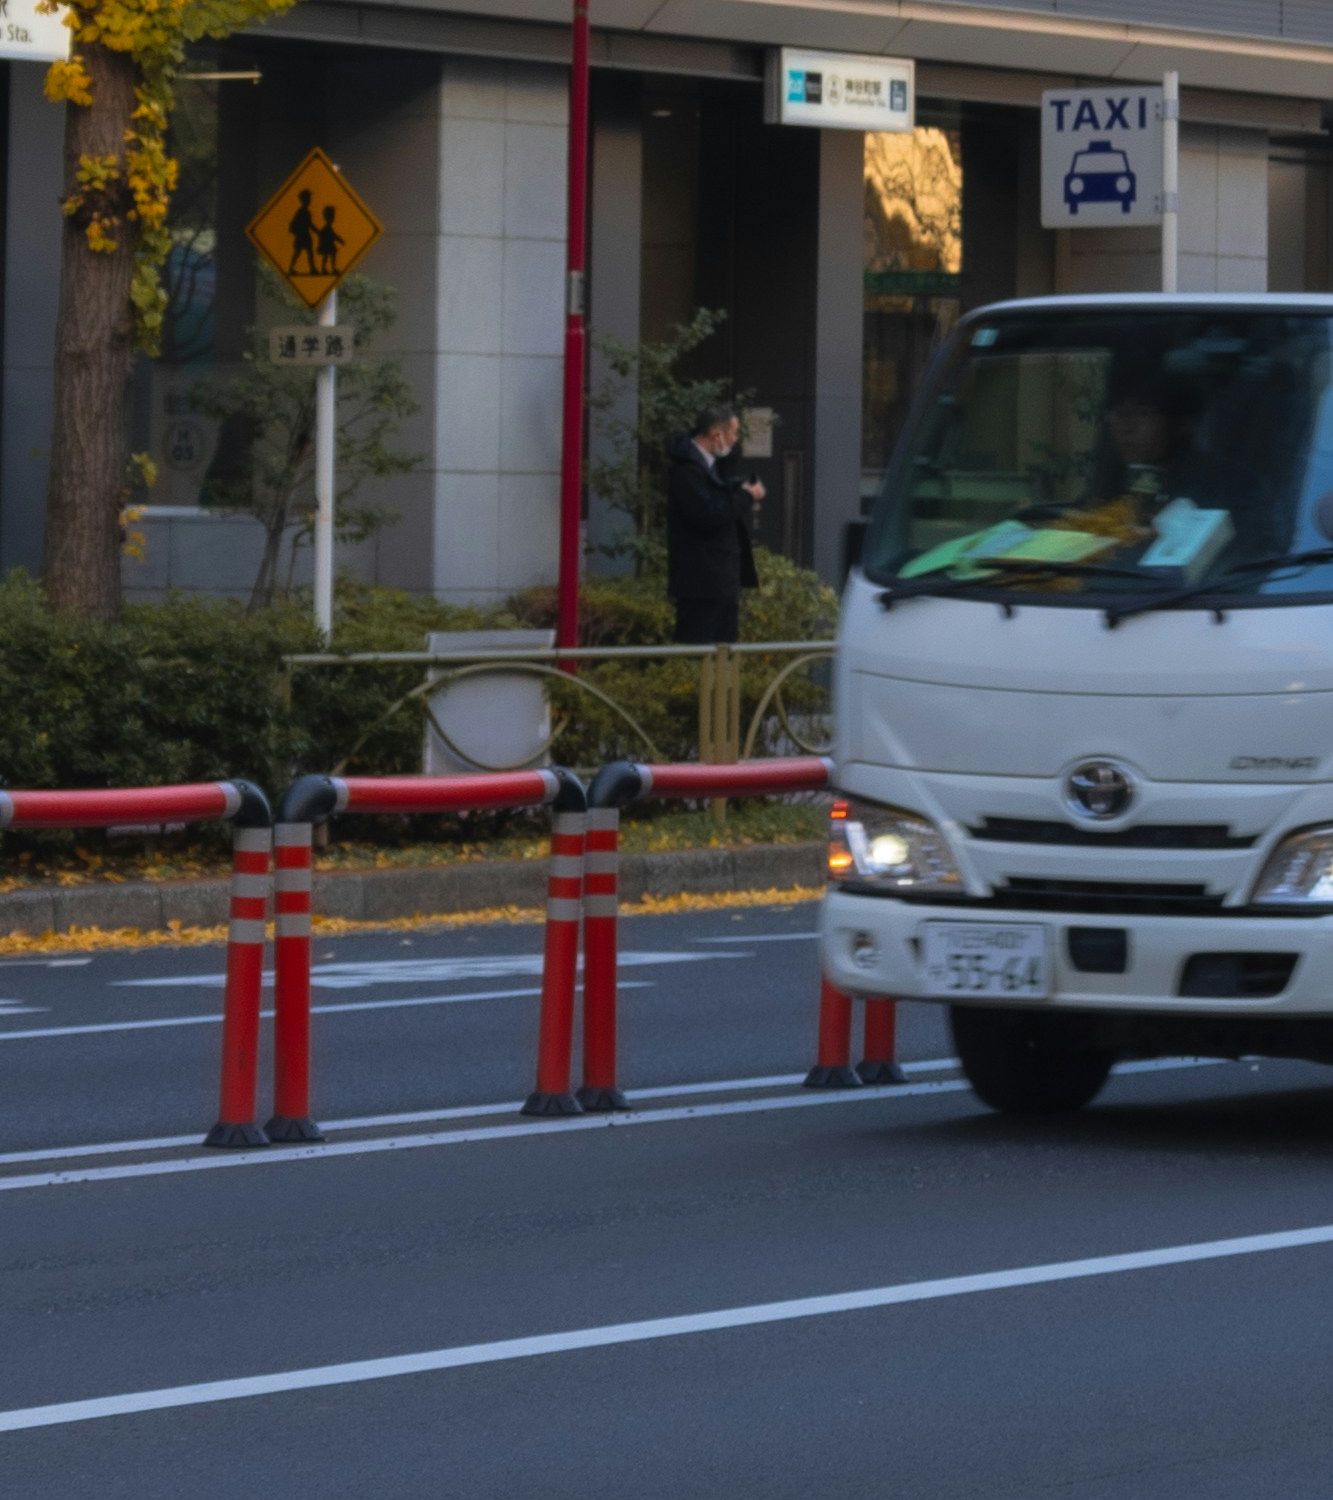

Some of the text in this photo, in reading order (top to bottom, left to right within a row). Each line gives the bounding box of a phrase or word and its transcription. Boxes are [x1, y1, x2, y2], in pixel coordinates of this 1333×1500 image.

[7, 23, 33, 42] Sta.
[1049, 96, 1147, 132] TAXI
[279, 335, 344, 358] 通学路
